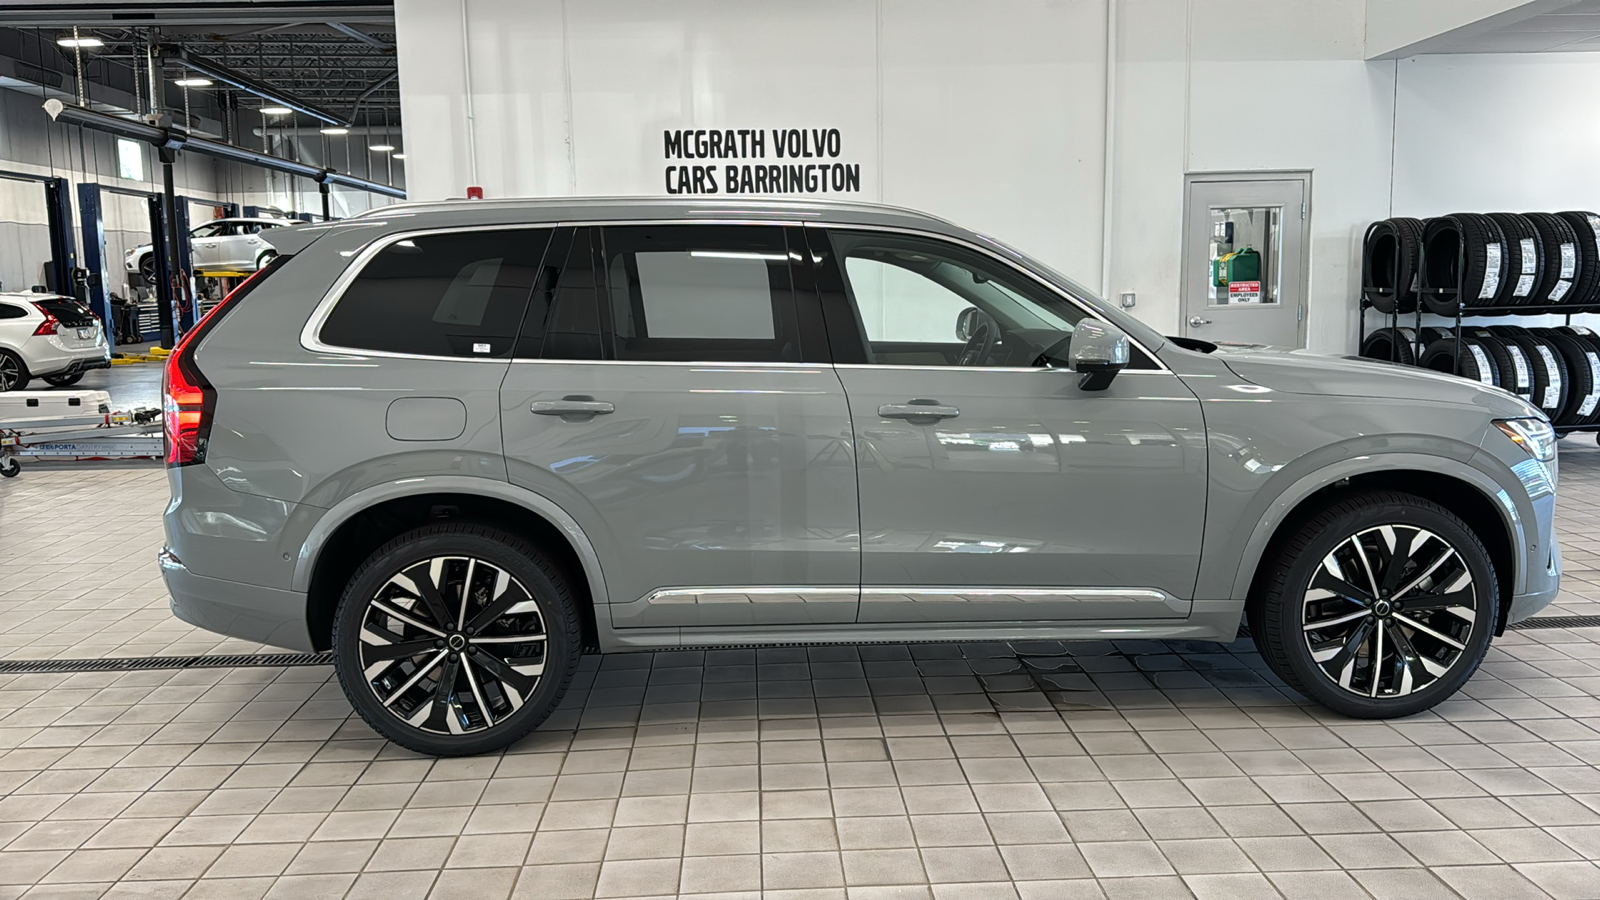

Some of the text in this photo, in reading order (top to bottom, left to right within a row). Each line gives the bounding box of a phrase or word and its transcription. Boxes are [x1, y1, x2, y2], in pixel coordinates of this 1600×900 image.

[664, 128, 841, 159] MCGRATH VOLVO
[665, 163, 860, 194] CARS BARRINGTON
